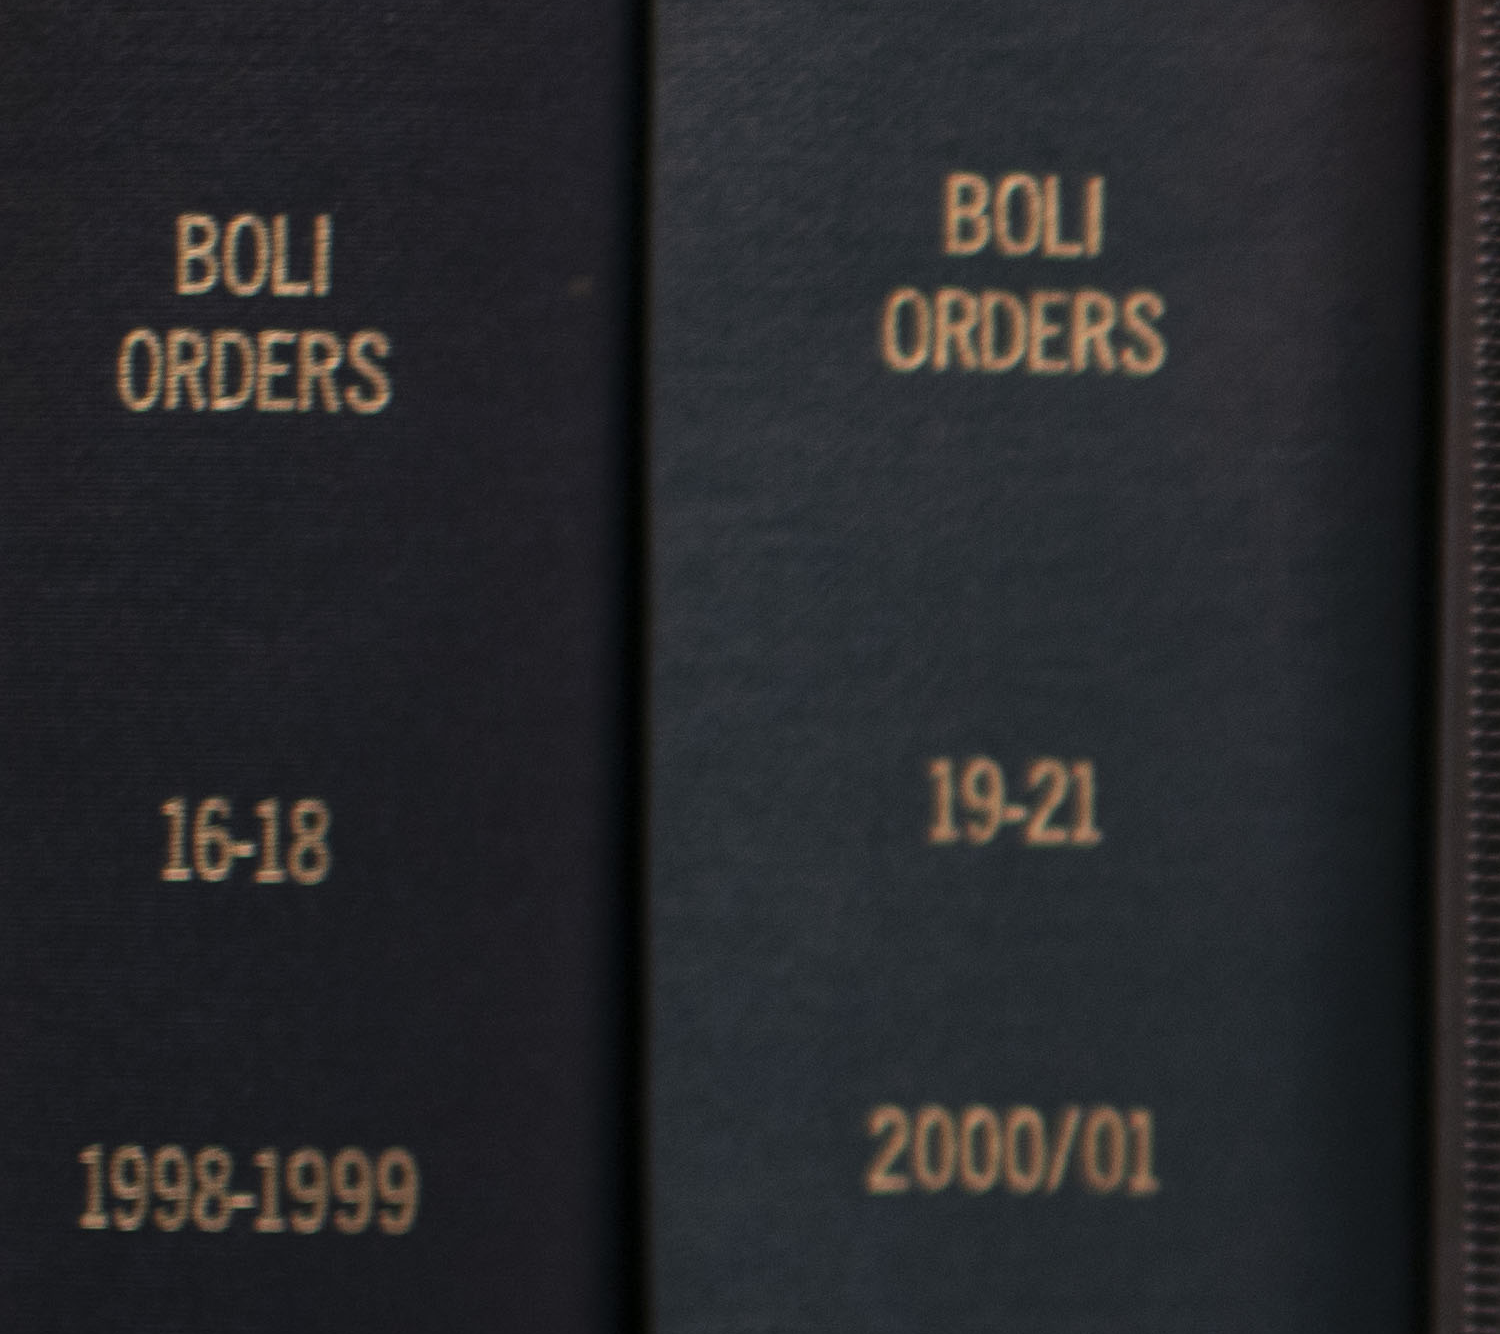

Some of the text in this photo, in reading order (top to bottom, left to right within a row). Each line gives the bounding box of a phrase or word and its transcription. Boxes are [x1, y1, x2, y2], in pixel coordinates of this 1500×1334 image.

[176, 212, 332, 297] BOLI
[945, 173, 1103, 257] BOLI
[118, 329, 392, 414] ORDERS
[882, 289, 1166, 375] ORDERS
[160, 798, 331, 885] 16-18
[928, 757, 1101, 846] 19-21
[77, 1143, 419, 1235] 1998-1999
[865, 1105, 1160, 1196] 2000/01
